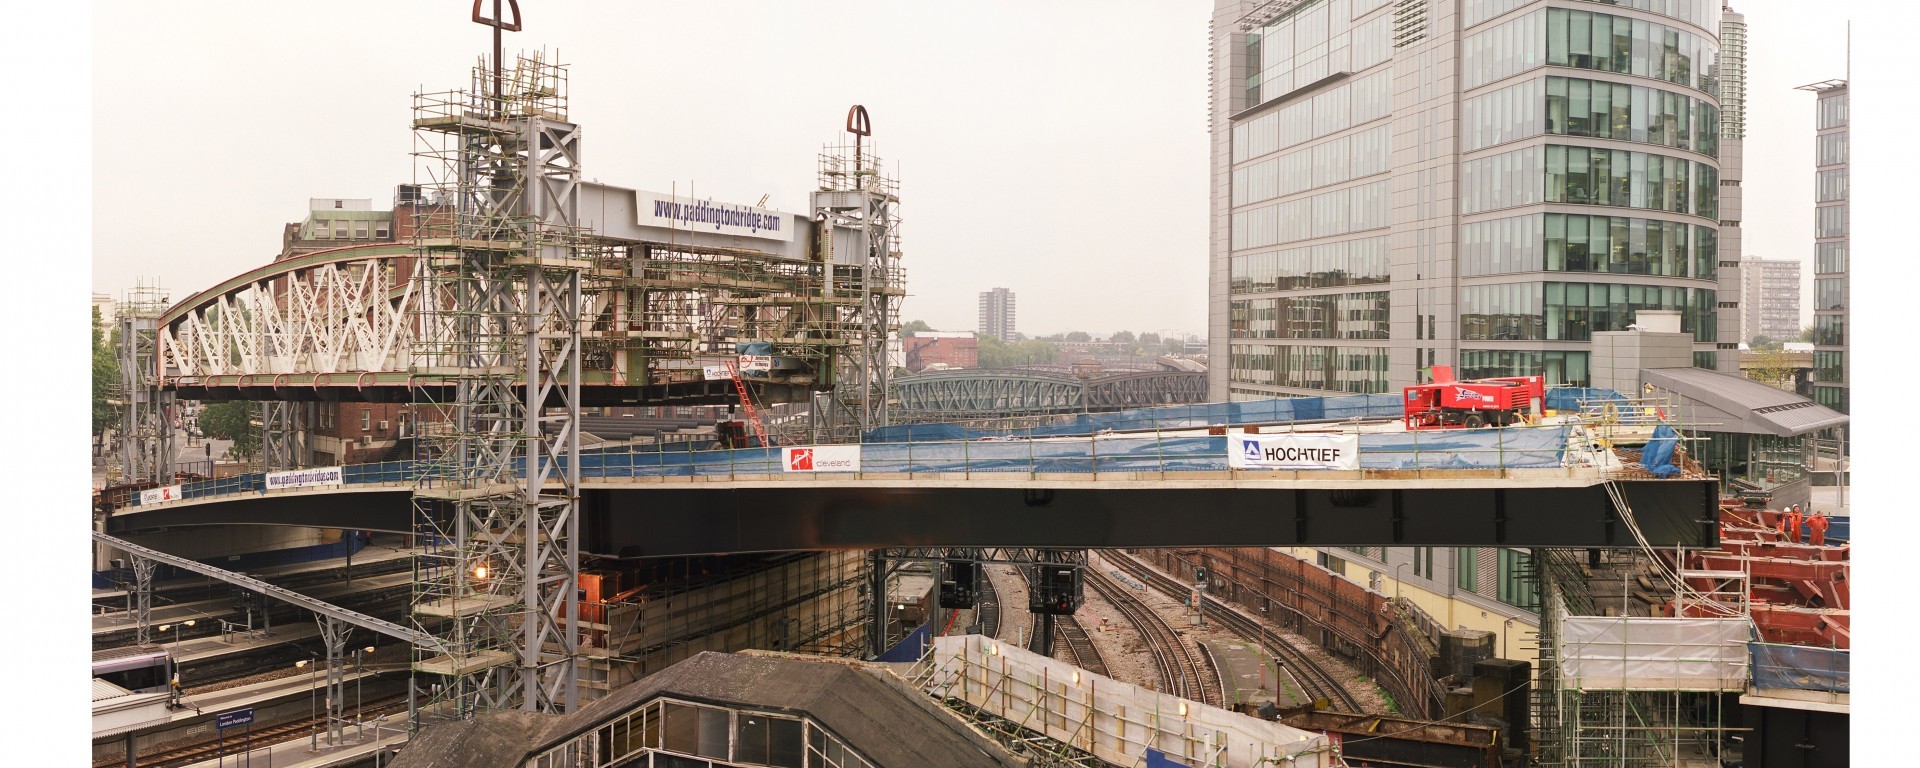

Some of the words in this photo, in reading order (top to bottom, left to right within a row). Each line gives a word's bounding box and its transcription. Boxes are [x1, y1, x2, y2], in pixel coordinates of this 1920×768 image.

[654, 199, 780, 233] www.paddingtonbridge.com
[1265, 447, 1340, 461] HOCHTIEF
[816, 459, 851, 467] cleveland
